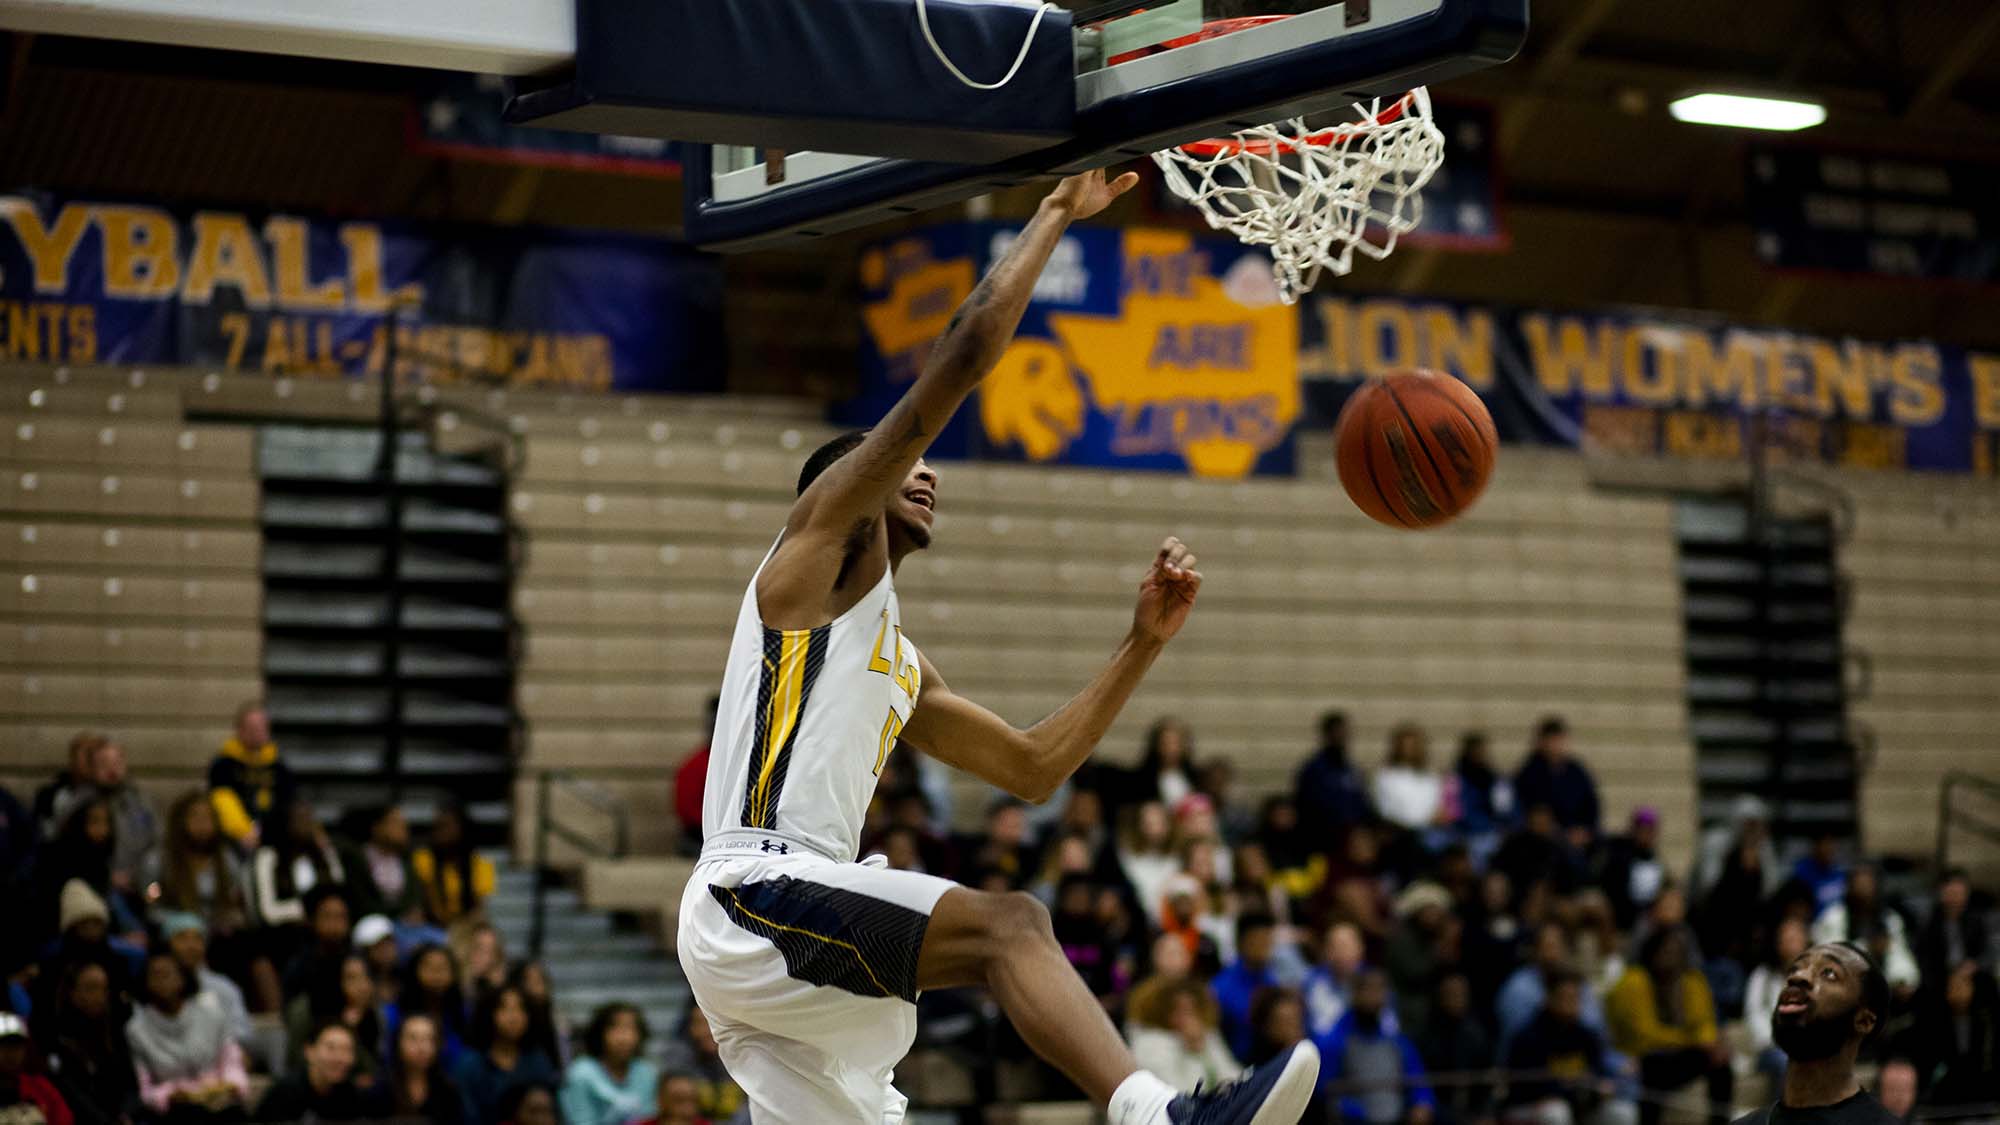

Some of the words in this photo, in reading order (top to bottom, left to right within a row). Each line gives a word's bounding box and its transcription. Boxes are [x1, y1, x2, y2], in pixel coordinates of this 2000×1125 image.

[220, 312, 249, 370] 7
[1148, 322, 1254, 371] ARE
[1522, 314, 1944, 425] WOMEN'S
[1110, 396, 1279, 456] LIONS
